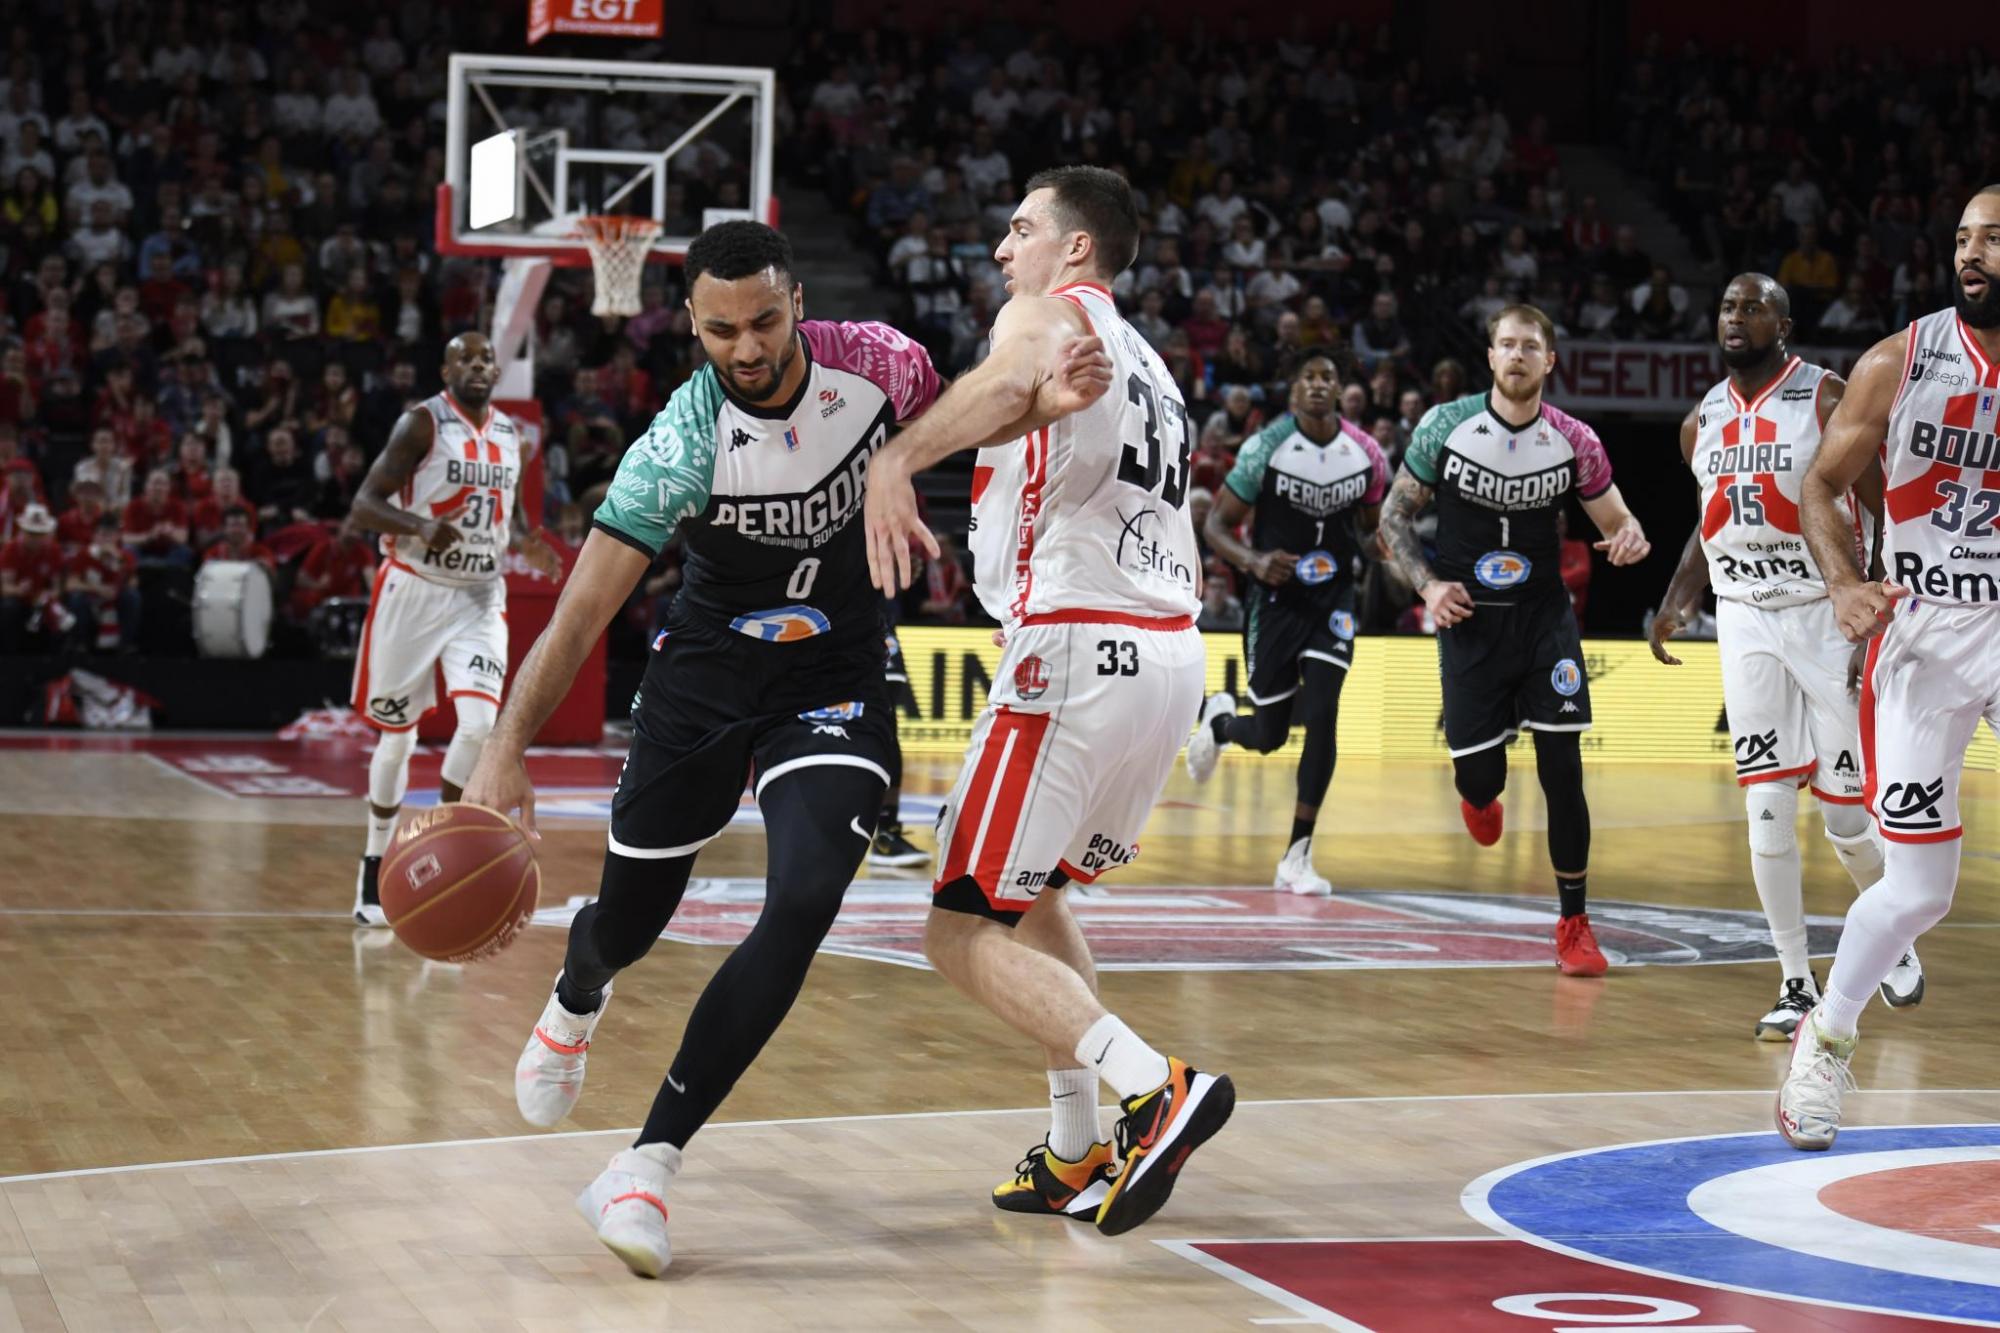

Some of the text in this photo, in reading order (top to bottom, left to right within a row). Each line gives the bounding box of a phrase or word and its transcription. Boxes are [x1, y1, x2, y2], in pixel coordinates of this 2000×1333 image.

[571, 0, 640, 20] EGT
[1117, 372, 1191, 512] 33
[1708, 443, 1793, 476] BOURG
[446, 459, 514, 490] BOURG
[1275, 473, 1367, 510] PERIGORD
[1443, 454, 1571, 505] PERIGORD
[461, 494, 497, 531] 31
[1725, 484, 1765, 526] 15
[1931, 480, 2000, 538] 32
[1499, 516, 1510, 548] 1
[786, 557, 822, 599] 0
[1894, 551, 2000, 602] Rém
[1096, 639, 1140, 677] 33
